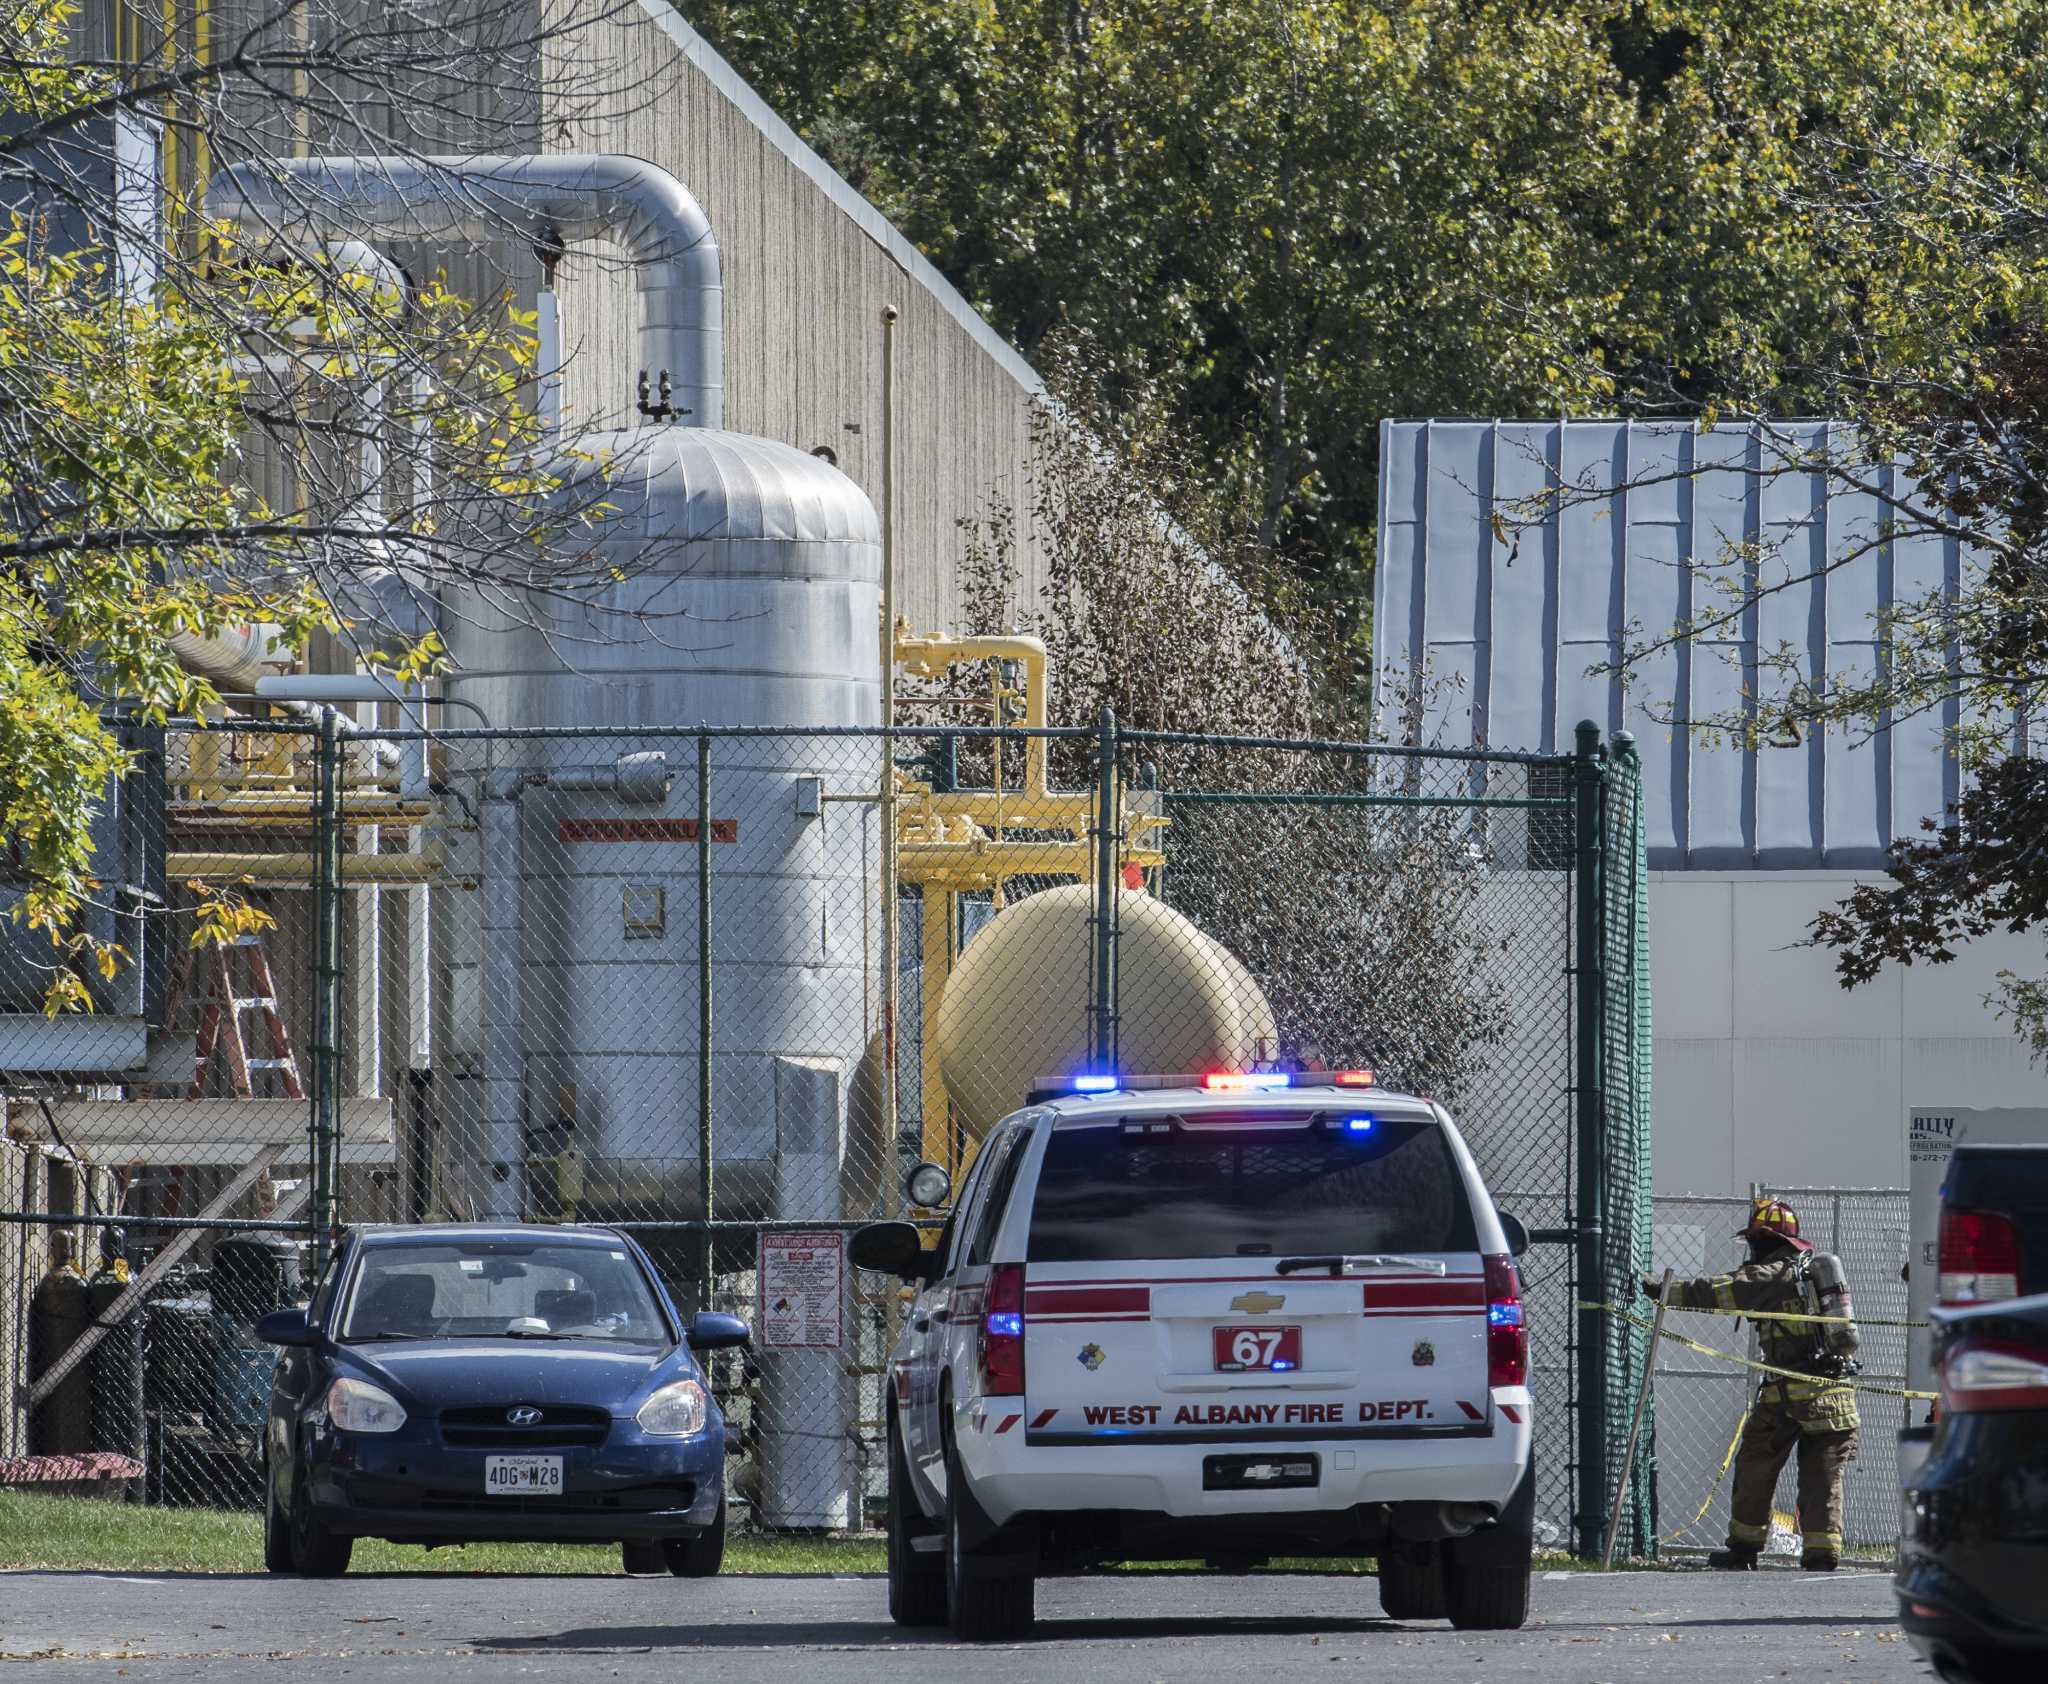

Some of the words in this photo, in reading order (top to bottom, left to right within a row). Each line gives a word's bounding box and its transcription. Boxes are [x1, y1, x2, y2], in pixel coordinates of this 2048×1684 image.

[1910, 1117, 1955, 1138] ALLY
[1232, 1331, 1283, 1366] 67
[1083, 1406, 1162, 1426] WEST
[1174, 1404, 1281, 1425] ALBANY
[1284, 1403, 1344, 1423] FIRE
[1359, 1400, 1434, 1422] DEPT.
[489, 1466, 518, 1486] 4DG
[529, 1466, 559, 1486] M28
